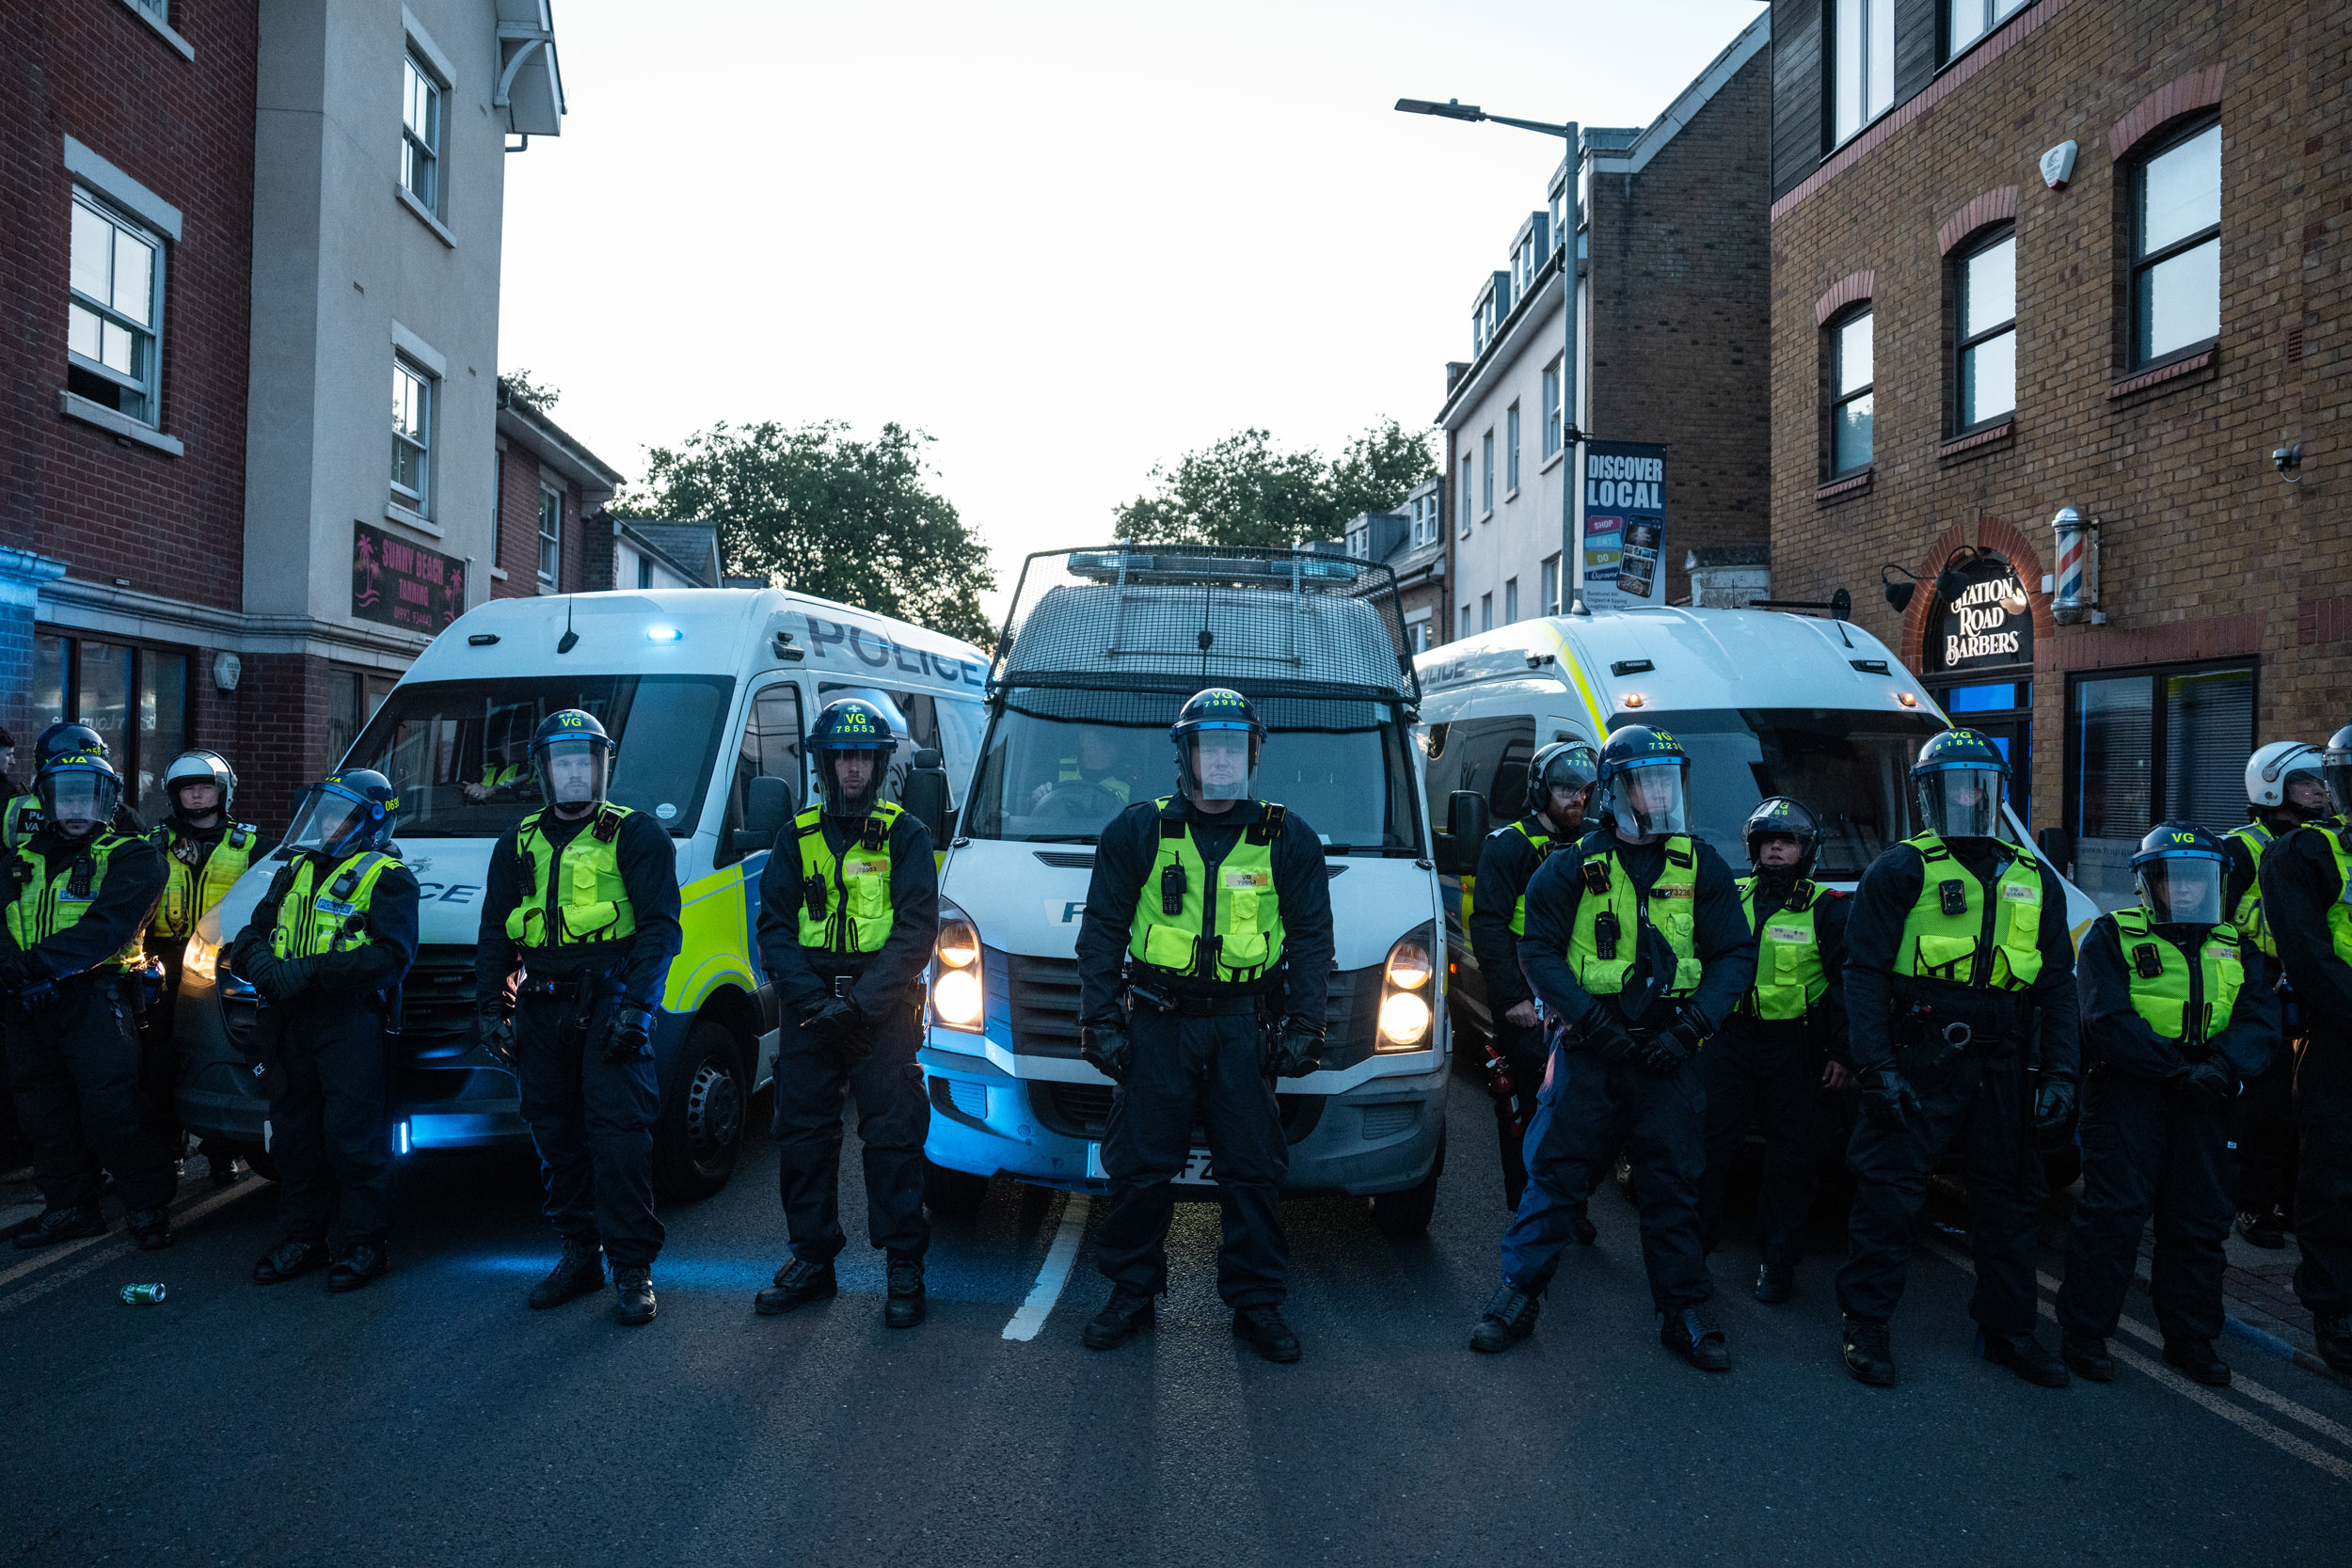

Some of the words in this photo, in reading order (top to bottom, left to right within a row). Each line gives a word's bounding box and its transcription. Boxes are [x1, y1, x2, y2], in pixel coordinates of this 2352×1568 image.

[1588, 454, 1663, 482] DISCOVER
[1587, 480, 1662, 509] LOCAL
[1594, 519, 1613, 530] SHOP
[1597, 537, 1613, 546] EAT
[382, 538, 414, 576] SUNNY
[416, 550, 444, 585] BEACH
[1597, 553, 1610, 563] DO
[398, 578, 429, 607] TANNING
[1960, 607, 2005, 638] ROAD
[806, 613, 983, 688] POLICE
[1946, 630, 2019, 666] BARBERS
[562, 717, 581, 727] VG
[846, 713, 866, 724] VG
[835, 724, 876, 734] 78553
[1949, 731, 1972, 739] VG
[1651, 732, 1674, 741] VG
[1935, 738, 1984, 751] 81844
[2171, 832, 2195, 844] VG
[252, 1062, 265, 1077] ICE
